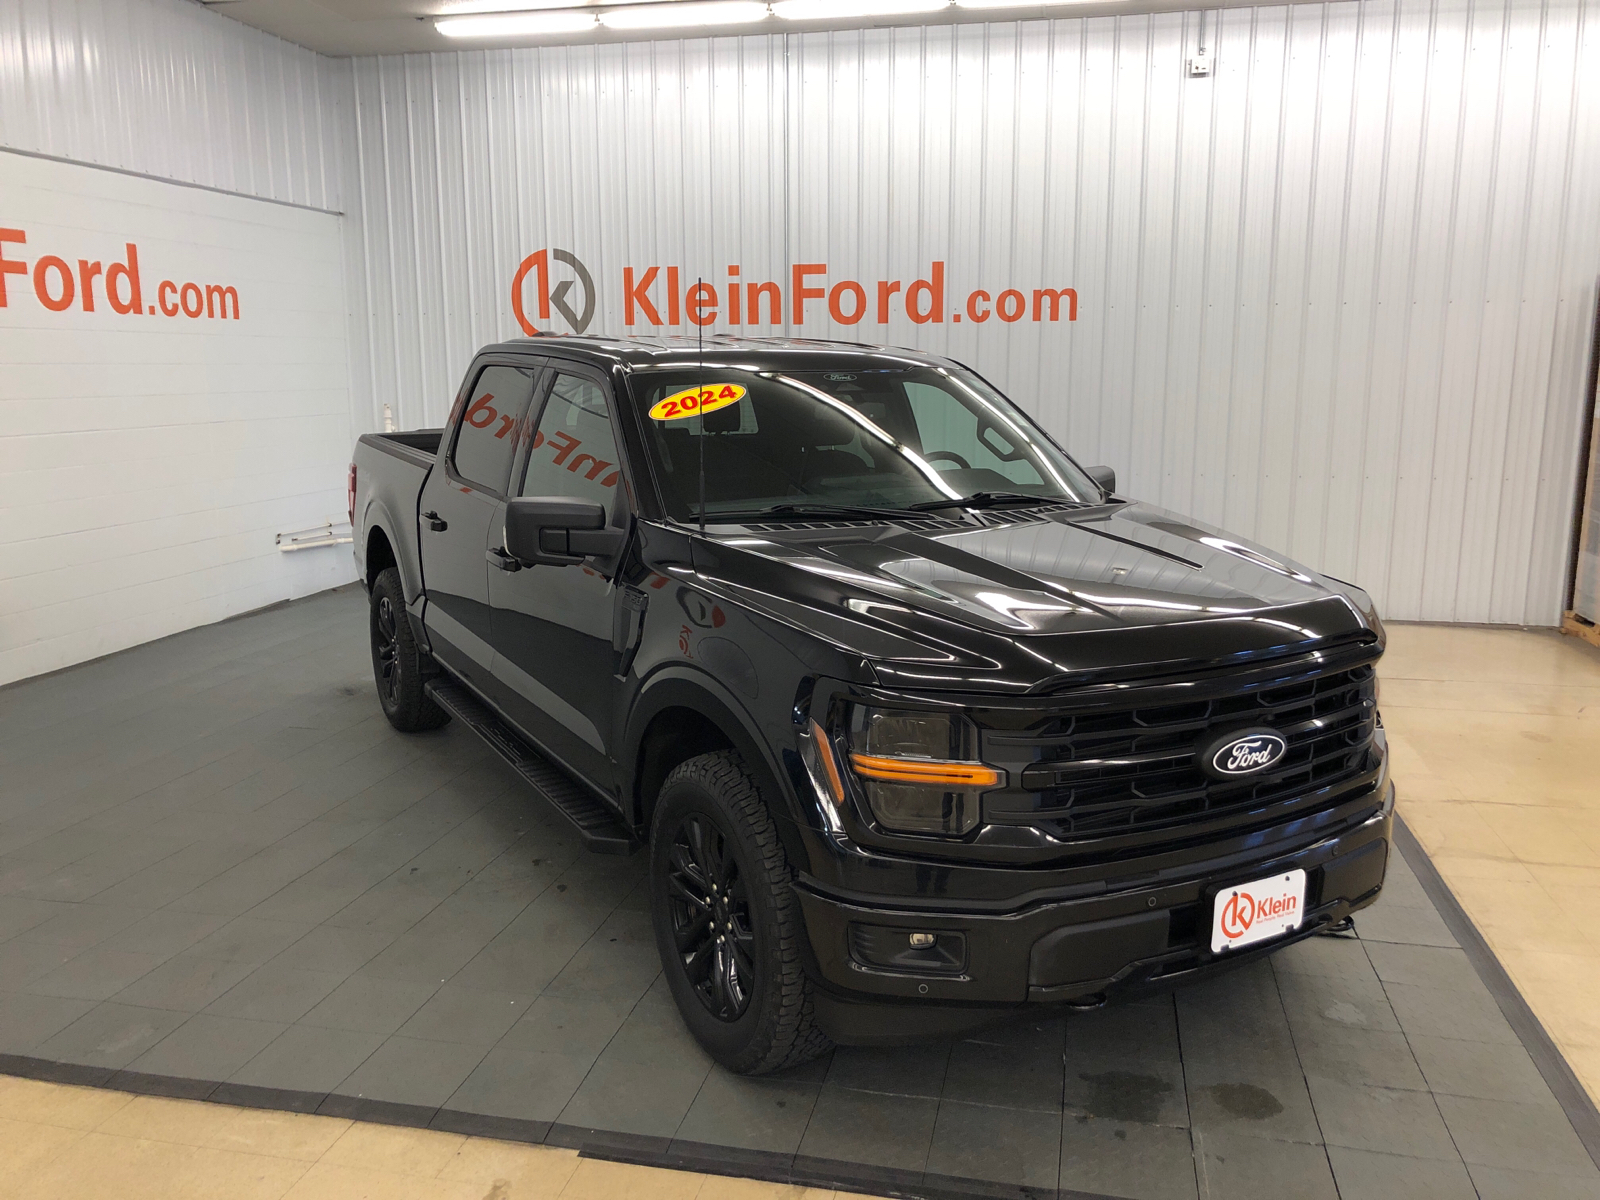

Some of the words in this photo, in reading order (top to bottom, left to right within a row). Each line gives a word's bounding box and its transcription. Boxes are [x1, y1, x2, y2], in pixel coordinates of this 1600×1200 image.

[623, 261, 1078, 326] KleinFord.com
[661, 385, 737, 417] 2024
[1227, 740, 1273, 769] Ford
[1257, 893, 1296, 919] Klein
